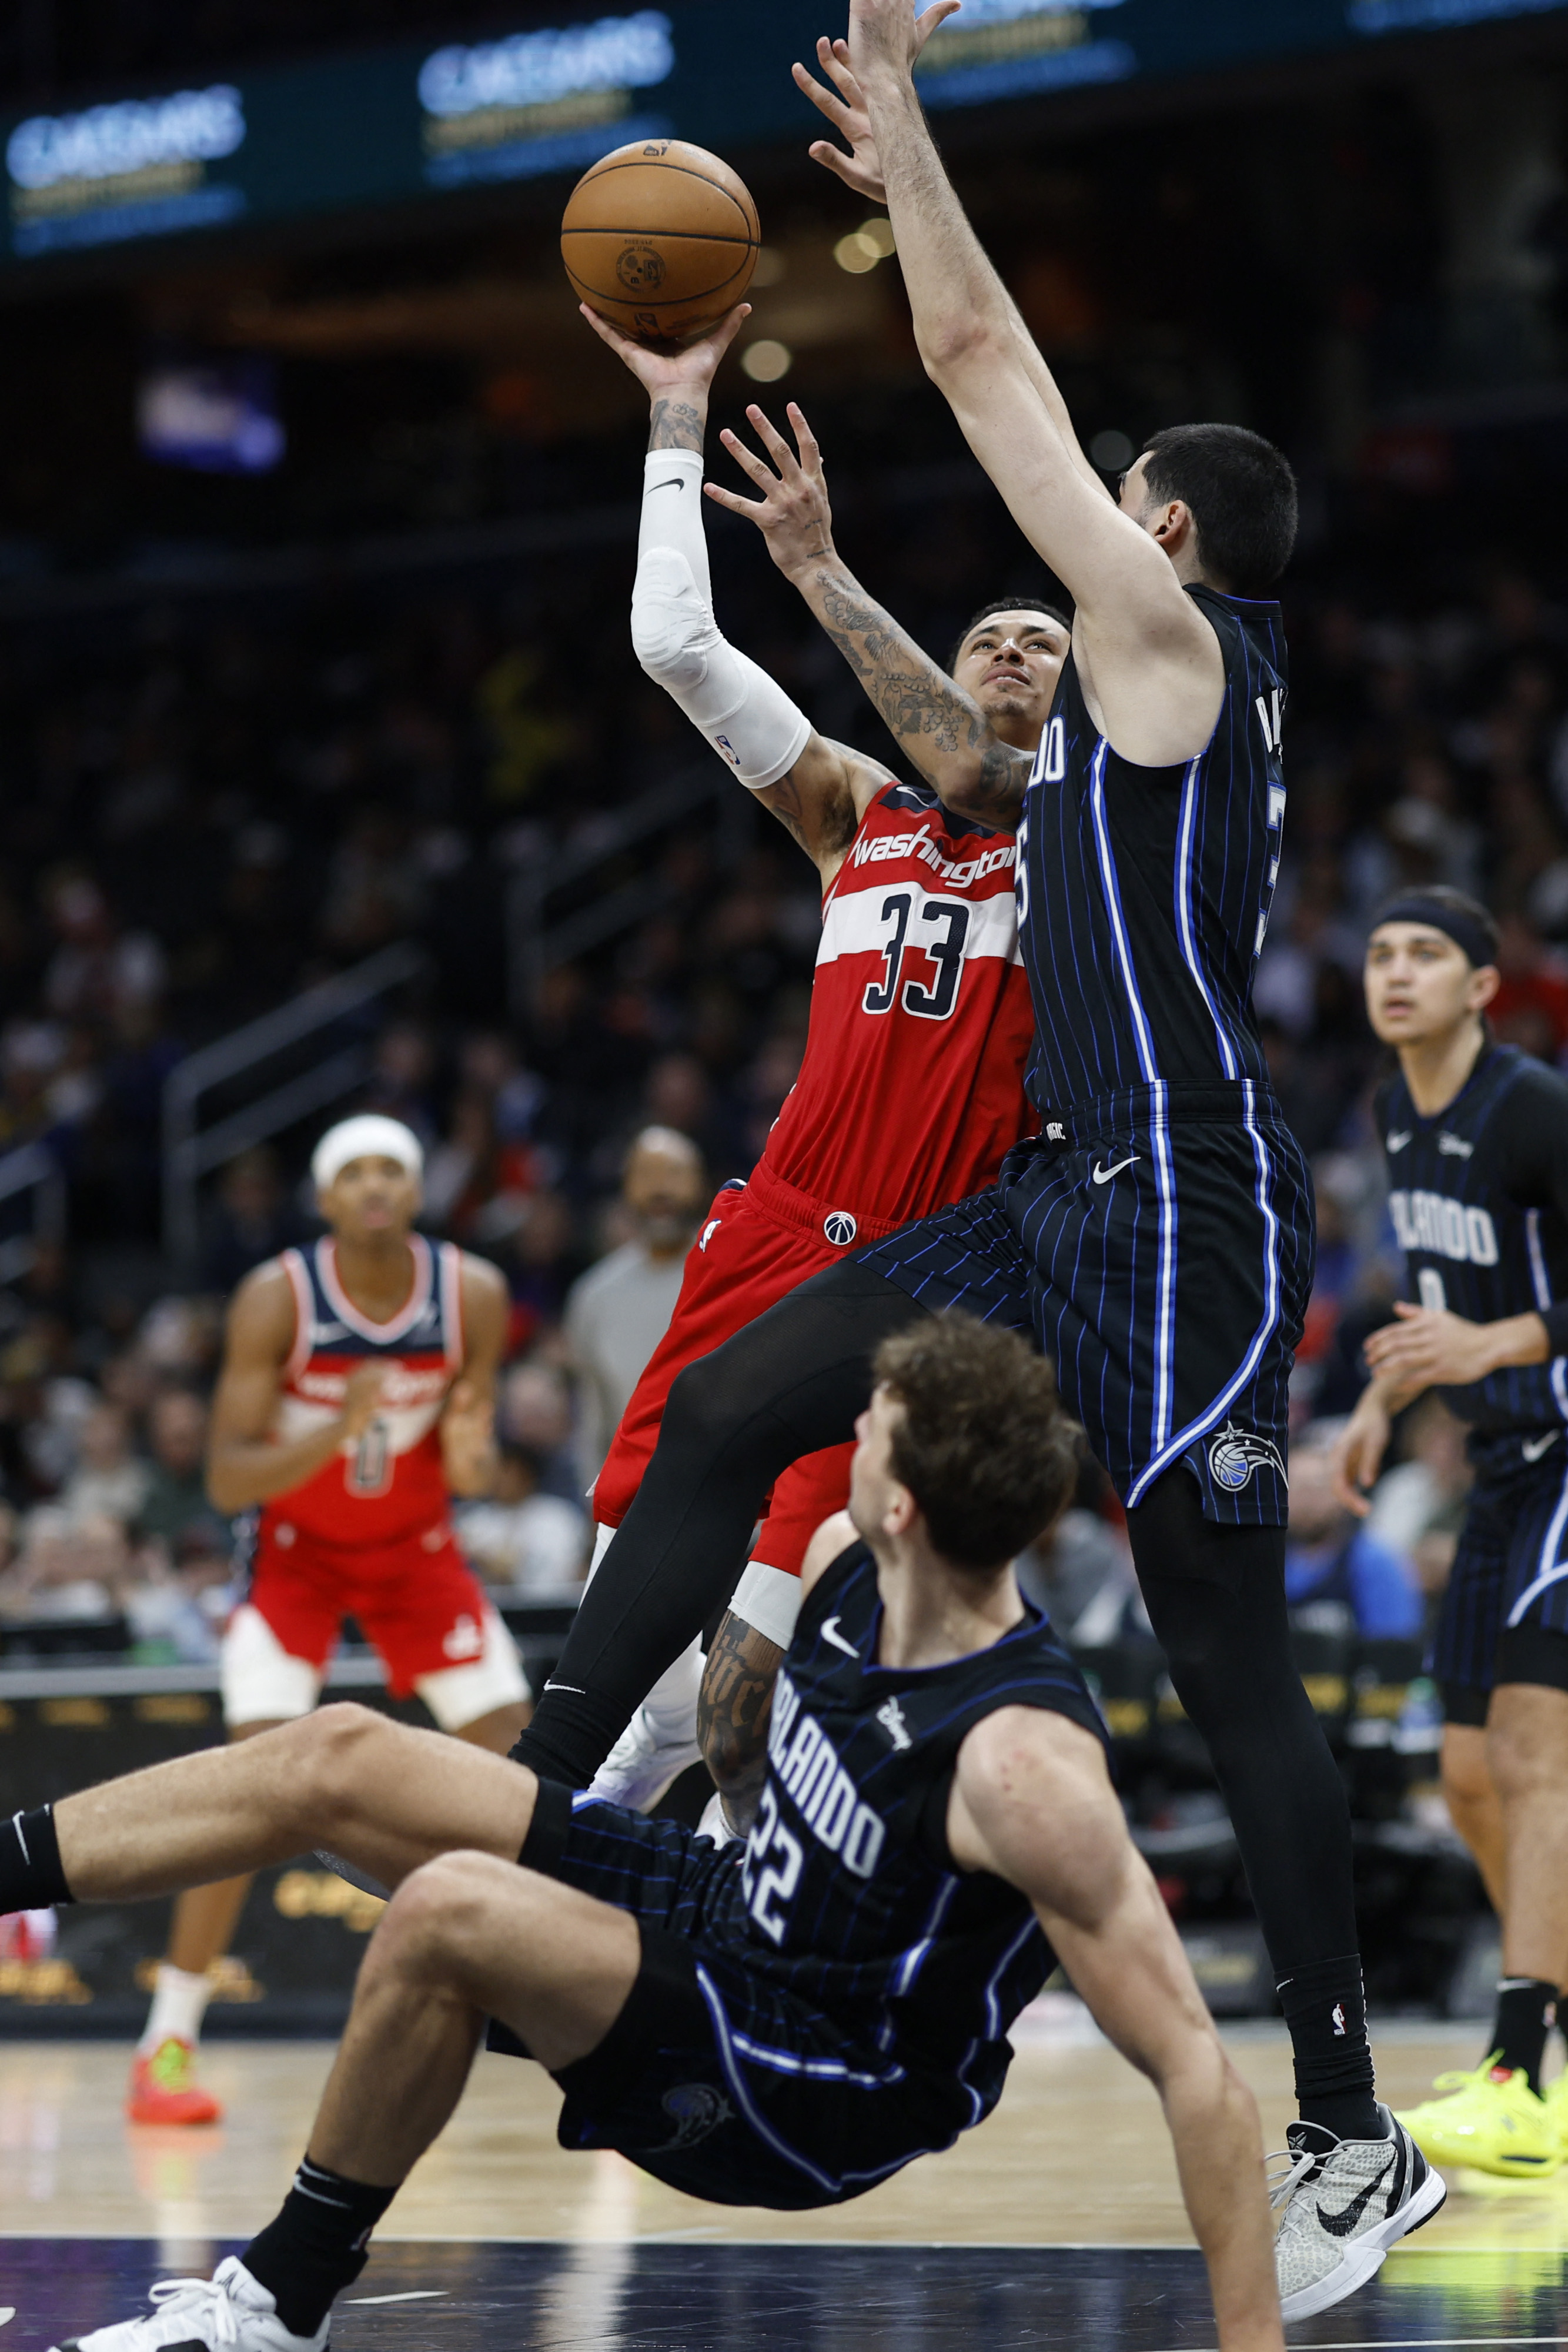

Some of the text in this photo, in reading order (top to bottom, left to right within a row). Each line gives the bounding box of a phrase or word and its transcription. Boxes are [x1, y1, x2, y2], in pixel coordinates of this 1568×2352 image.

[862, 890, 972, 1020] 33
[767, 1666, 885, 1879] RLANDO
[741, 1780, 804, 1948] 22
